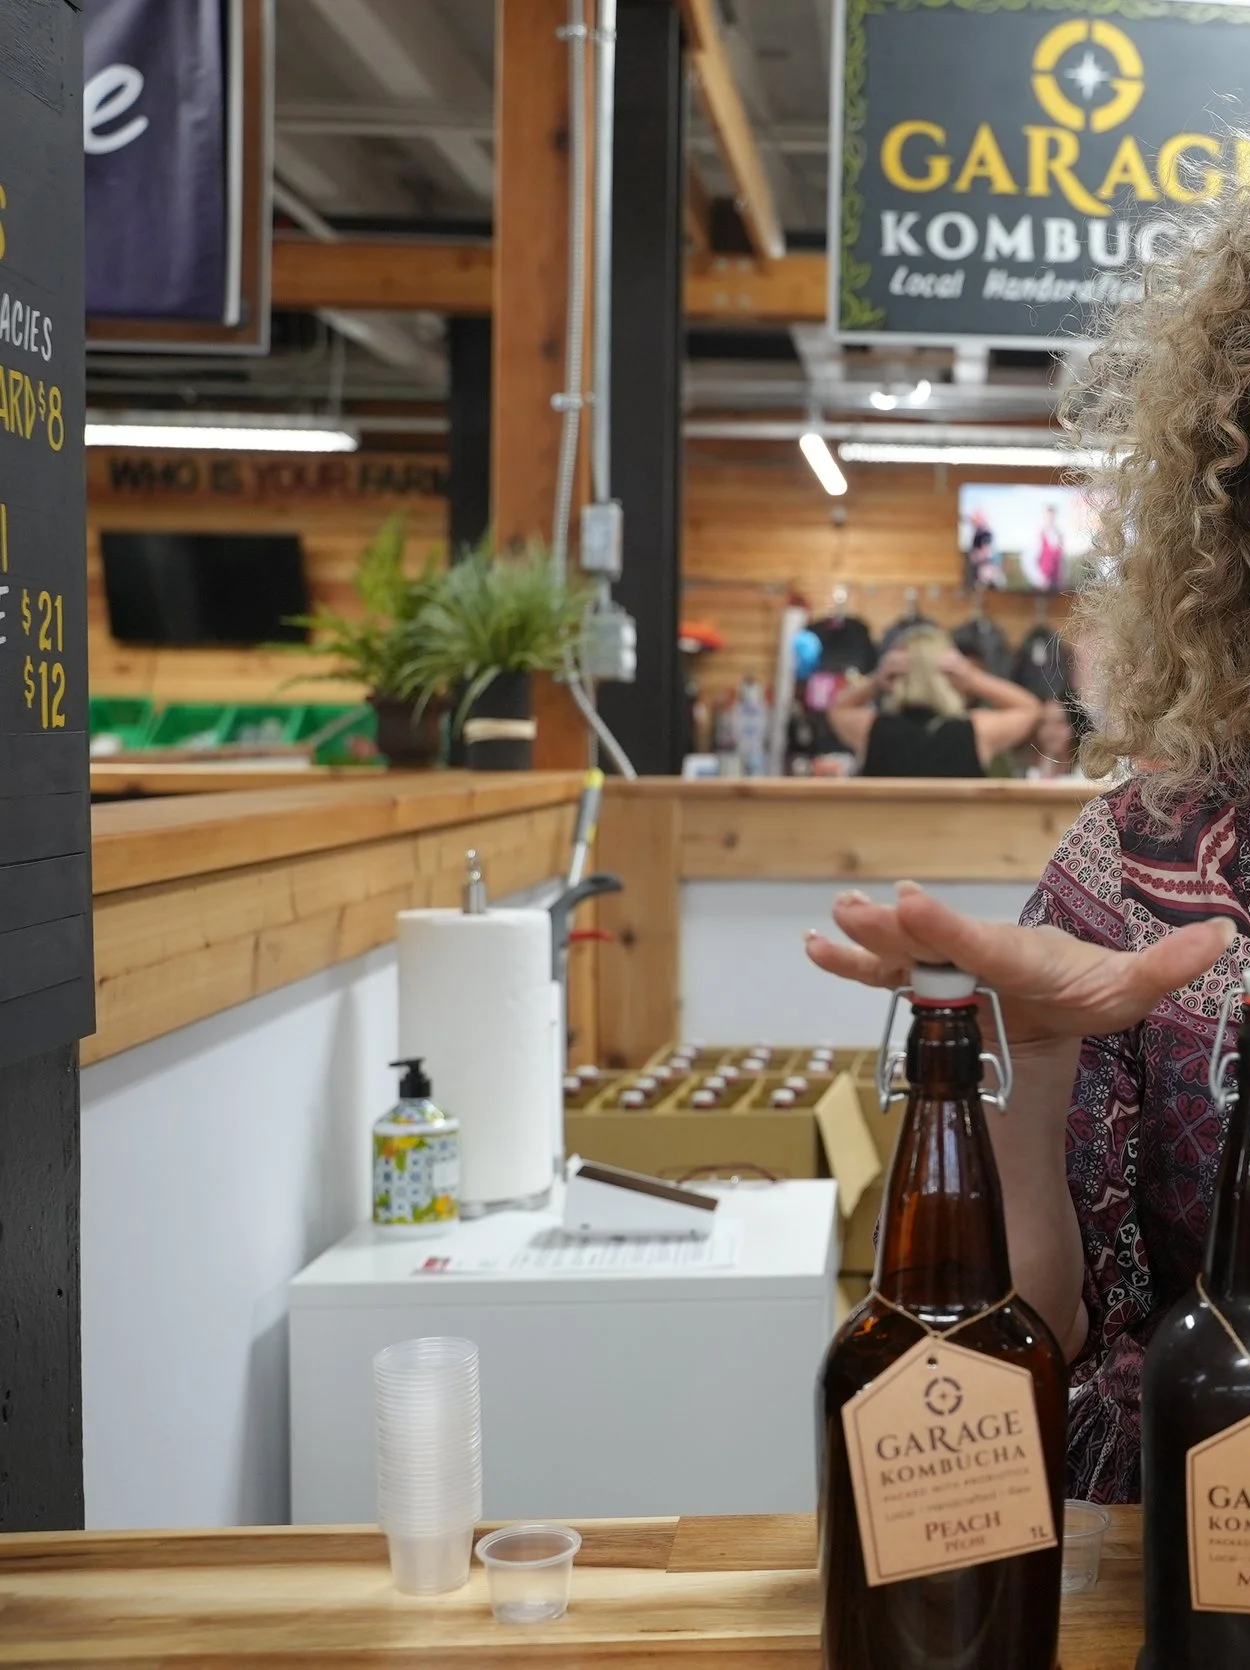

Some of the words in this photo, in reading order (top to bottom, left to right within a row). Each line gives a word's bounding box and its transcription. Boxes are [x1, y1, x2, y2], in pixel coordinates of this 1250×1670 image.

[880, 210, 1216, 266] KOMBUC
[889, 266, 966, 300] Local
[21, 588, 63, 652] $21
[23, 655, 66, 729] $12
[875, 1409, 1023, 1462] GARAGE
[880, 1445, 1027, 1488] KOMBUCHA
[925, 1510, 1002, 1542] PEACH
[1030, 1525, 1049, 1539] 1L
